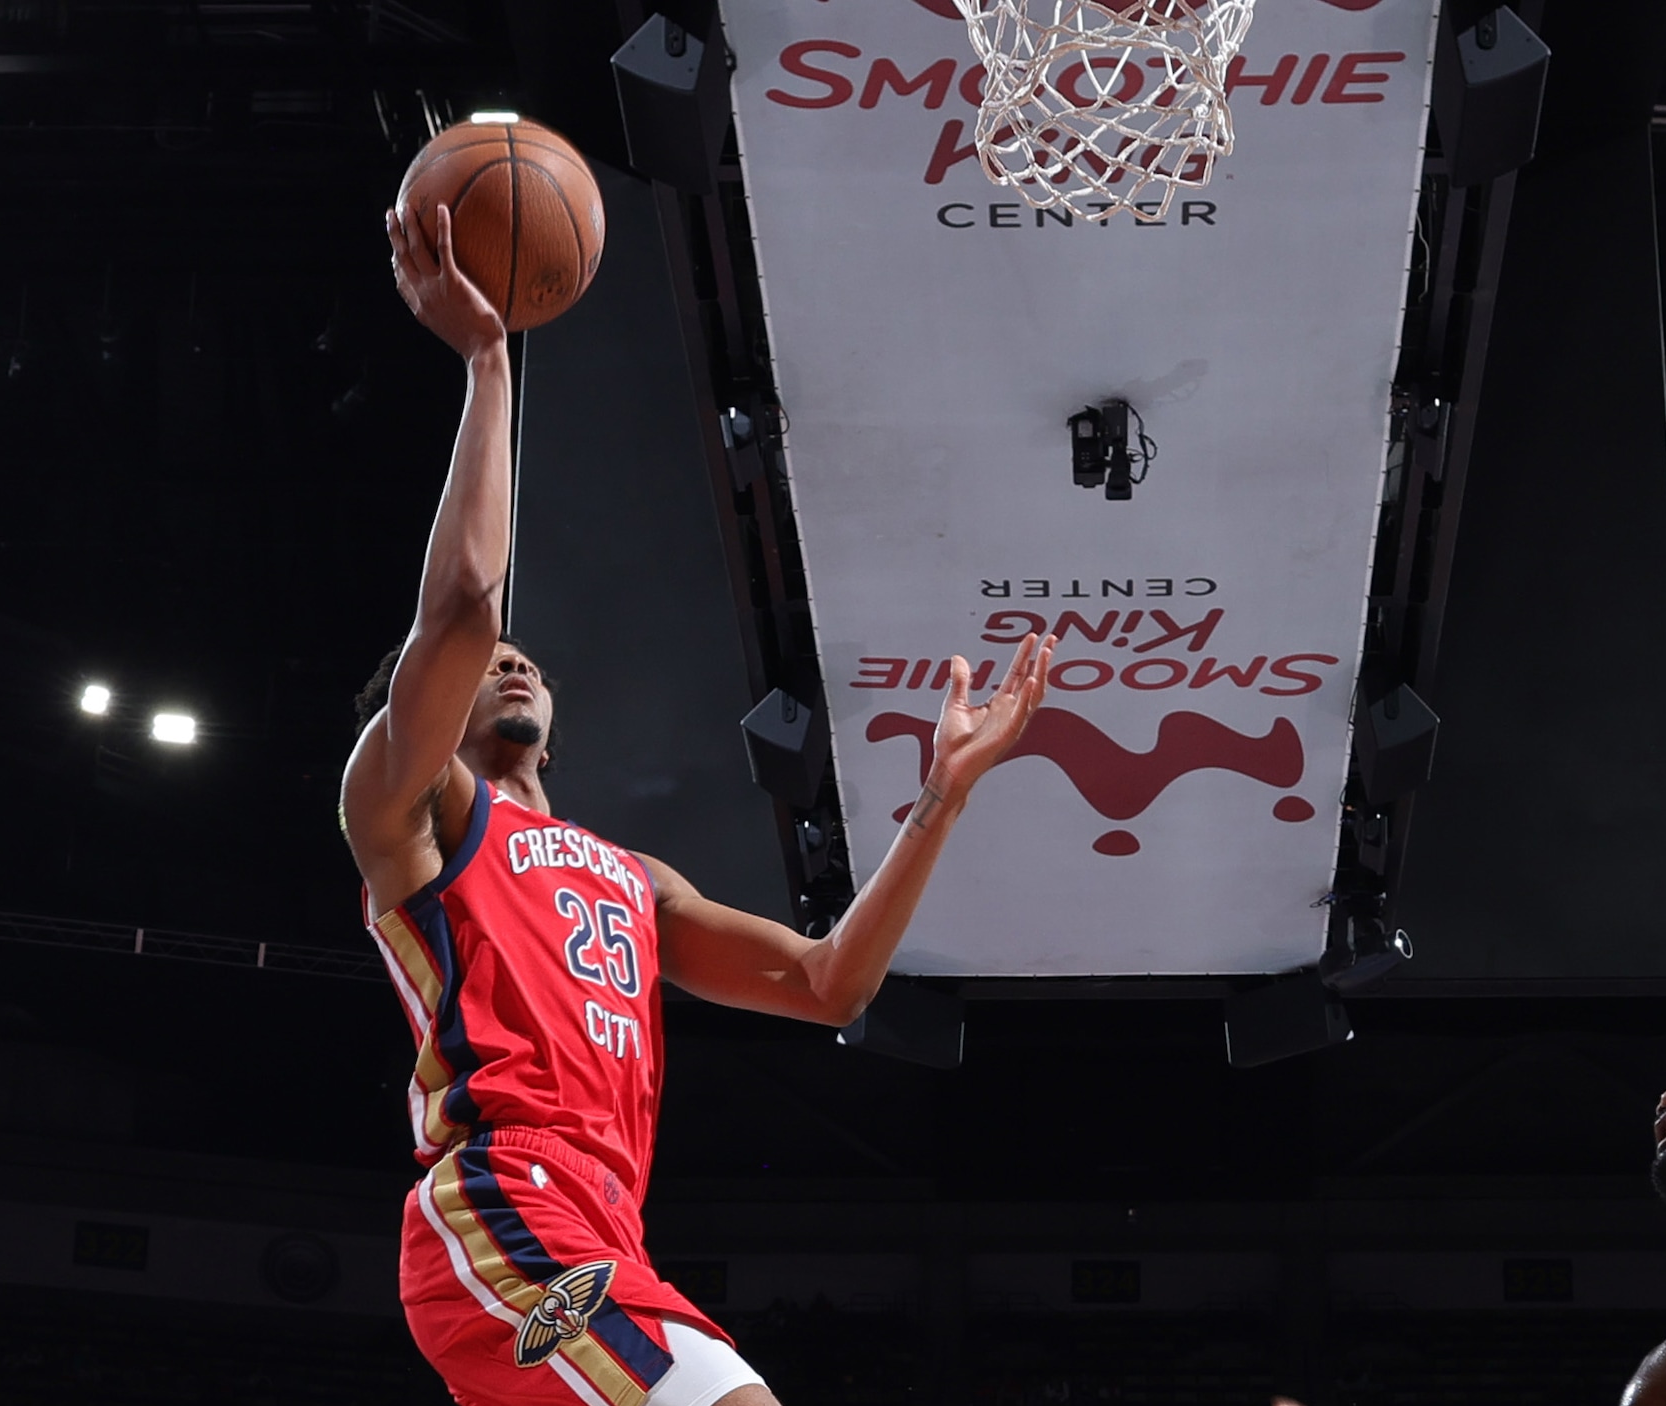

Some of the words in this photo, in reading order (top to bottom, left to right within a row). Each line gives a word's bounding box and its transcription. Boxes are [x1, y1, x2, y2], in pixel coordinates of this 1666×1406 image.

[937, 201, 1216, 228] CENTER
[981, 577, 1217, 597] CENTER
[849, 653, 1339, 697] SMOOHIE
[507, 827, 645, 915] CRESCENT
[554, 887, 642, 998] 25
[585, 1000, 642, 1060] CITY
